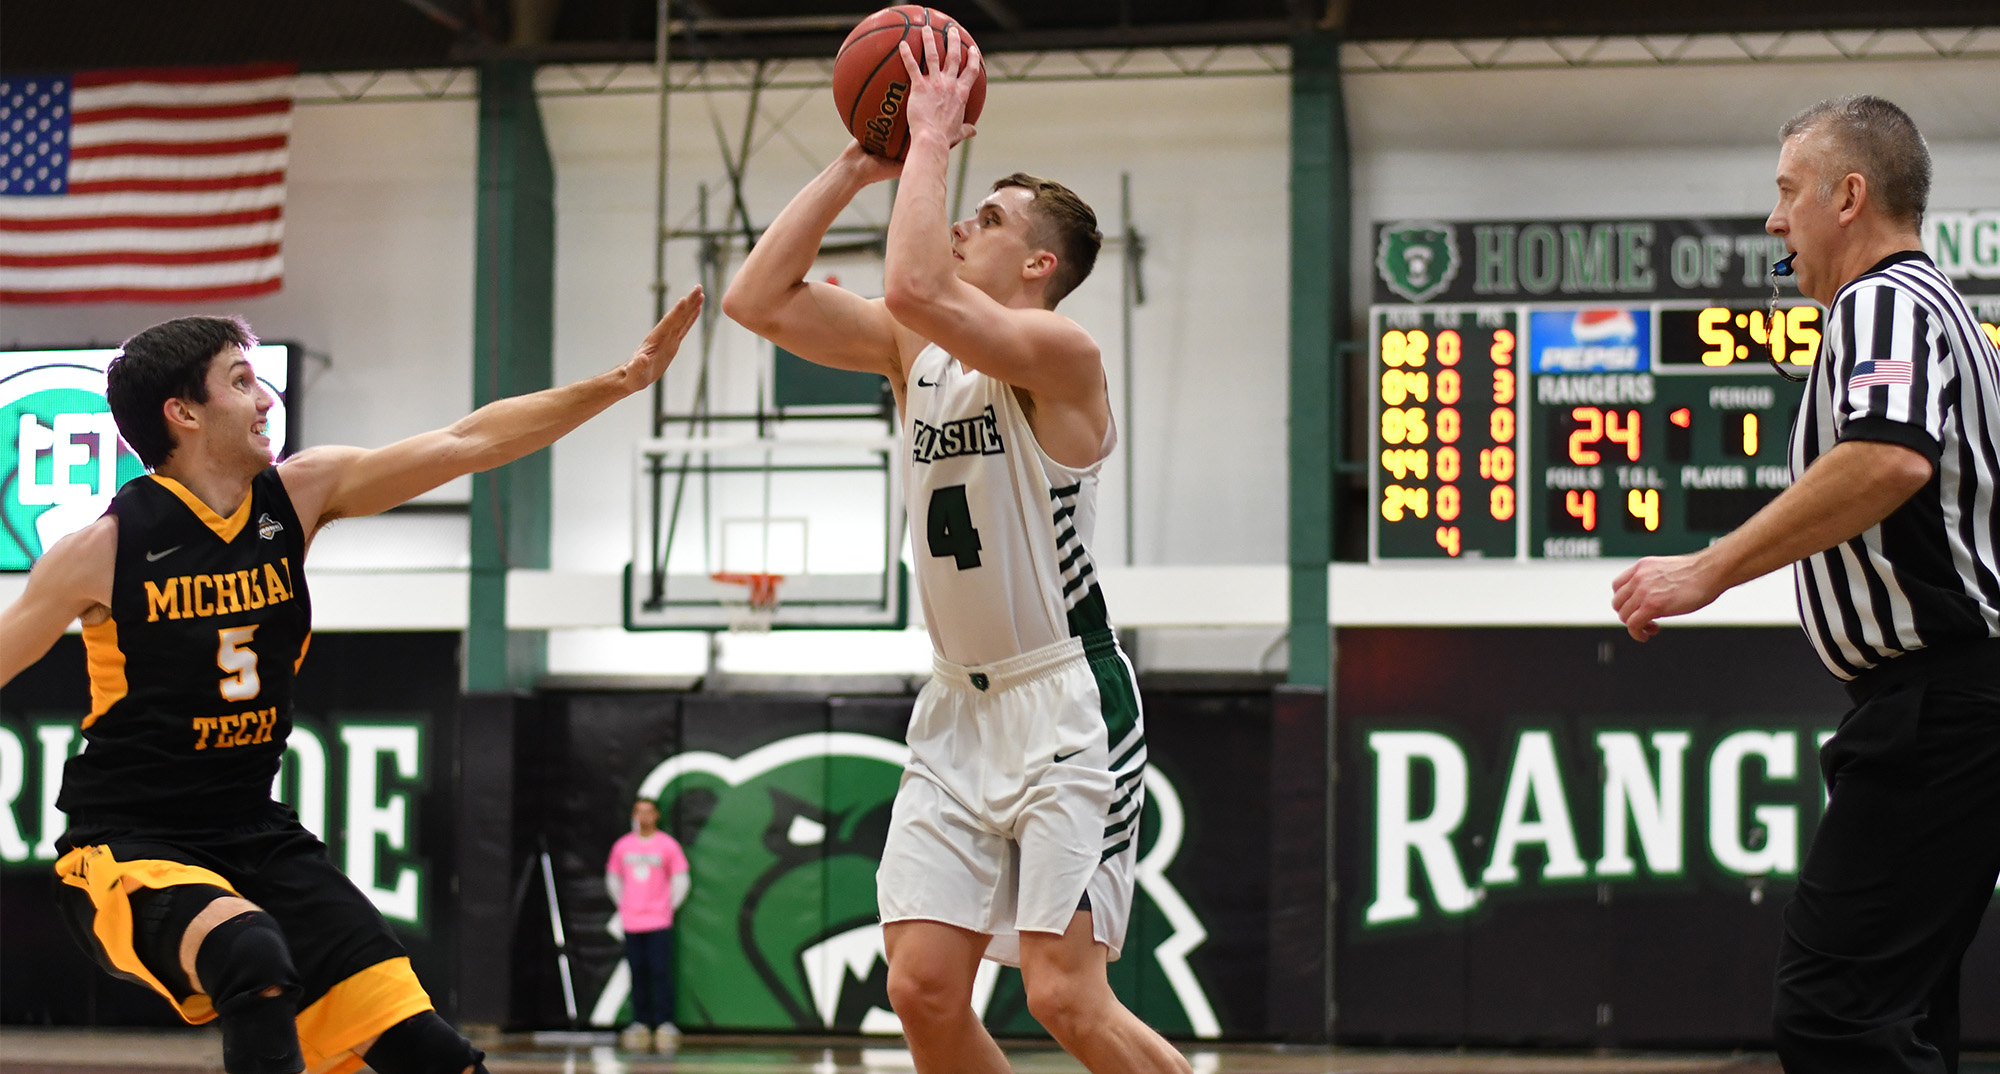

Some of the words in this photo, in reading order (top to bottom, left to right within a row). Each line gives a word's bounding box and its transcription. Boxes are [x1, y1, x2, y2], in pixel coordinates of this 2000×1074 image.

[1473, 223, 1656, 295] HOME
[1670, 235, 1731, 289] OF
[1382, 329, 1430, 368] 02
[1435, 329, 1462, 367] 0
[1490, 328, 1516, 367] 2
[1697, 306, 1823, 367] 5:45
[1540, 346, 1640, 371] PEPSI
[1382, 368, 1430, 406] 04
[1435, 368, 1462, 405] 0
[1492, 367, 1516, 405] 3
[1537, 374, 1655, 403] RANGERS
[1709, 387, 1775, 409] PERIOD
[1382, 407, 1429, 445] 05
[1435, 407, 1461, 444] 0
[1490, 406, 1516, 444] 0
[1568, 406, 1641, 466] 24
[1742, 412, 1758, 457] 1
[1381, 448, 1429, 480] 44
[1435, 446, 1461, 482] 0
[1479, 445, 1515, 482] 10
[1545, 467, 1603, 488] FOULS
[1681, 466, 1748, 488] PLAYER
[1756, 465, 1791, 488] FOU
[1381, 484, 1429, 522] 24
[1435, 484, 1461, 521] 0
[1490, 484, 1515, 521] 0
[1565, 489, 1597, 532] 4
[1628, 488, 1660, 532] 4
[927, 485, 982, 571] 4
[1435, 526, 1461, 557] 4
[1543, 538, 1601, 559] SCORE
[217, 624, 261, 702] 5
[192, 706, 277, 750] TECH
[1366, 730, 1838, 924] RANG
